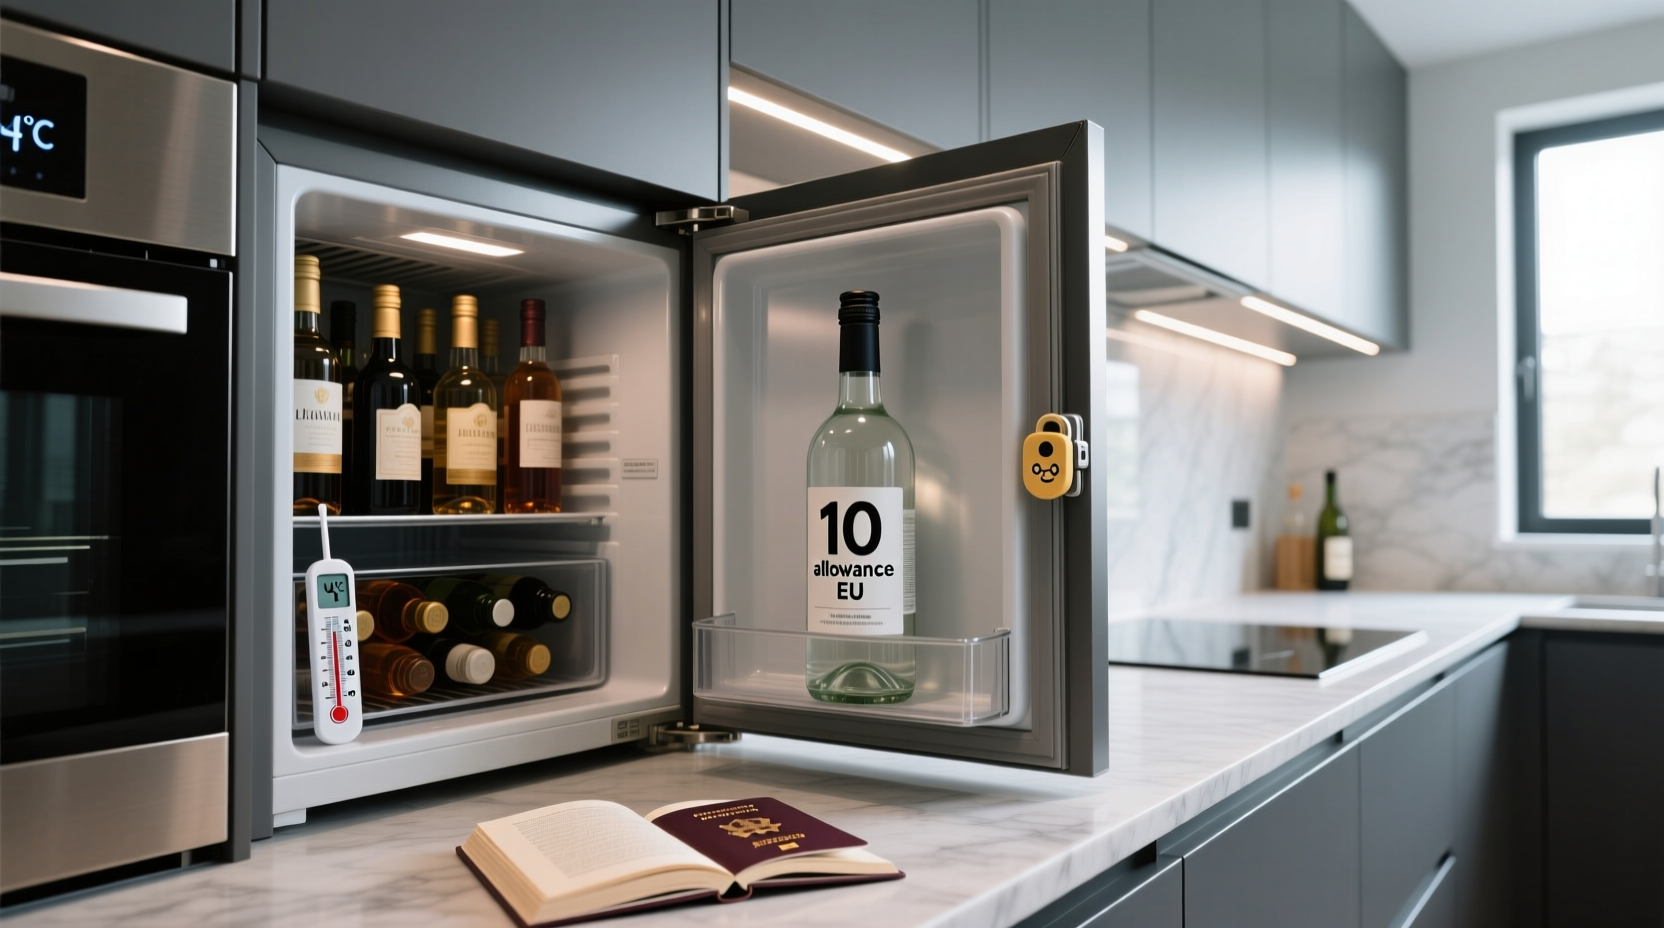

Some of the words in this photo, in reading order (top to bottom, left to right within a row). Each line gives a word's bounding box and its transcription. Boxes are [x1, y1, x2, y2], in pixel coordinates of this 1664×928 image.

[820, 501, 882, 556] 10
[813, 560, 895, 577] allowance
[837, 582, 864, 600] EU
